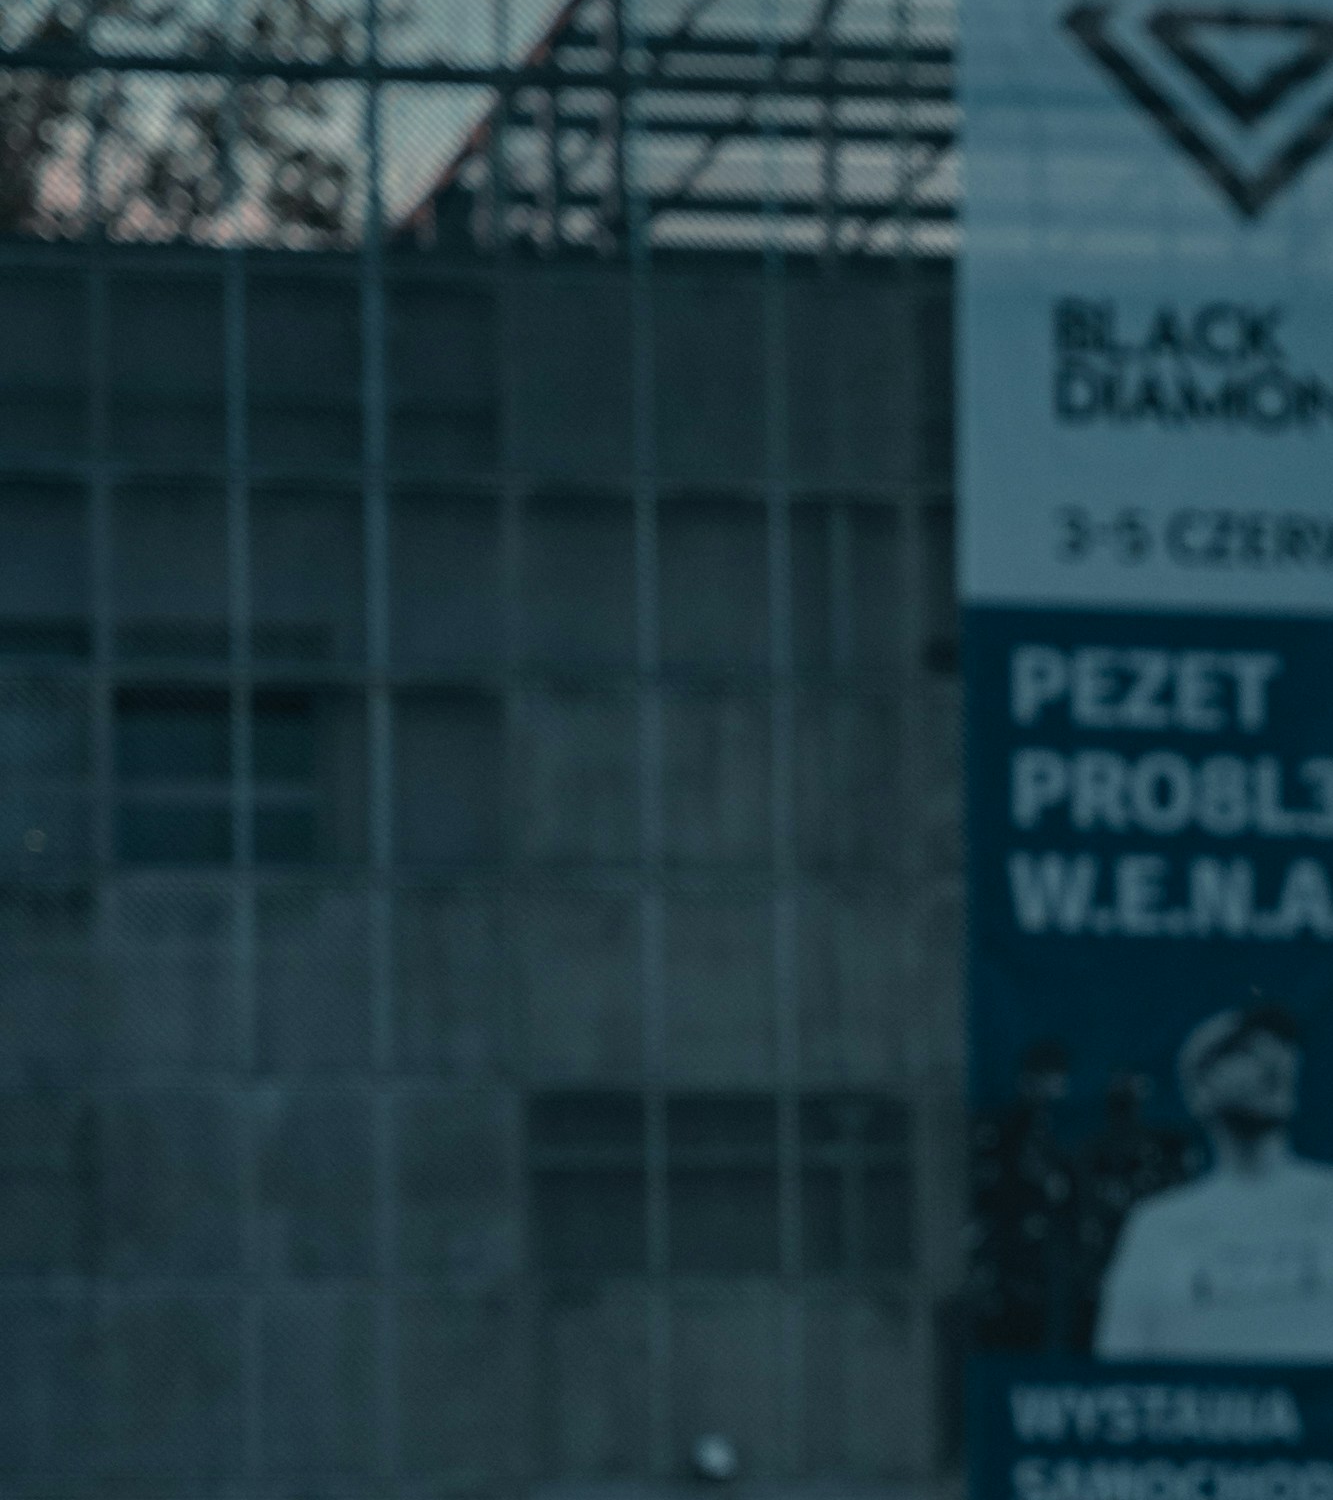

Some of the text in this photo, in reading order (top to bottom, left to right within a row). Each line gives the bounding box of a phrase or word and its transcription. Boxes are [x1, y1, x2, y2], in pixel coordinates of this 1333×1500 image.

[1051, 297, 1284, 362] BLACK
[1008, 644, 1282, 732] PEZET
[1008, 1384, 1302, 1443] WYSTAWA
